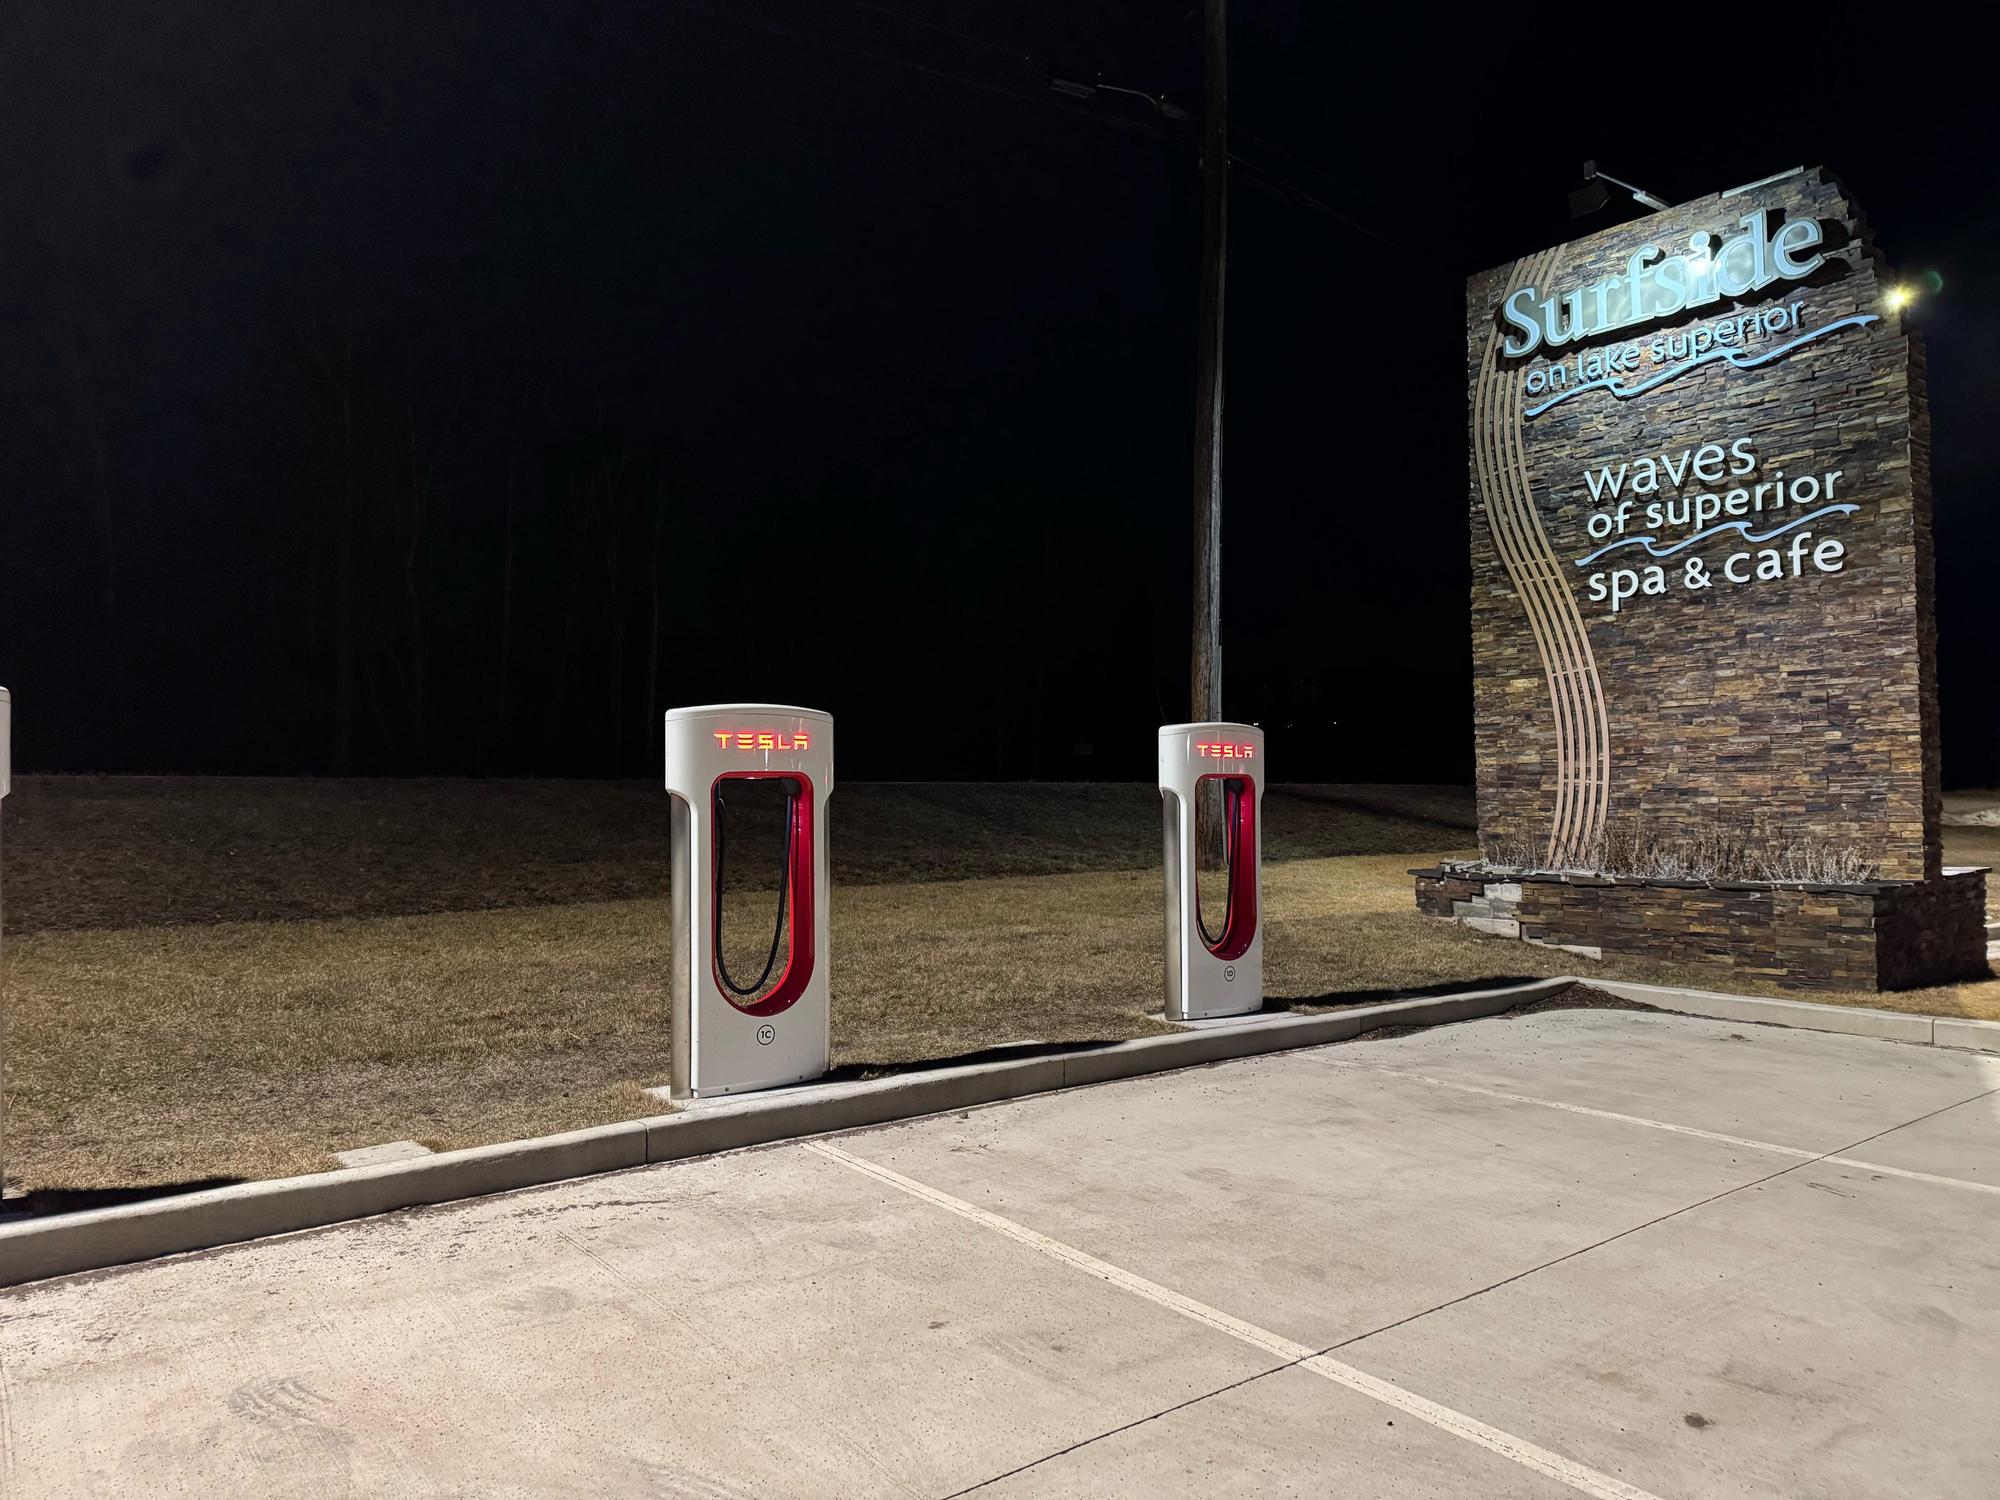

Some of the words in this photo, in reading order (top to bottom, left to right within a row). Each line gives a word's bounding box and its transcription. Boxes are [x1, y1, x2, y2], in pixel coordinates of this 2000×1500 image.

[1502, 208, 1824, 357] Surfside
[1525, 365, 1566, 395] on
[1577, 344, 1641, 383] lake
[1650, 300, 1804, 361] superior
[1584, 437, 1756, 502] waves
[1587, 501, 1633, 538] of
[1646, 470, 1842, 530] superior
[1588, 565, 1667, 612] spa
[1684, 556, 1713, 590] &
[1724, 531, 1845, 584] cafe
[713, 732, 808, 750] TESLA
[1195, 743, 1253, 758] TESLA
